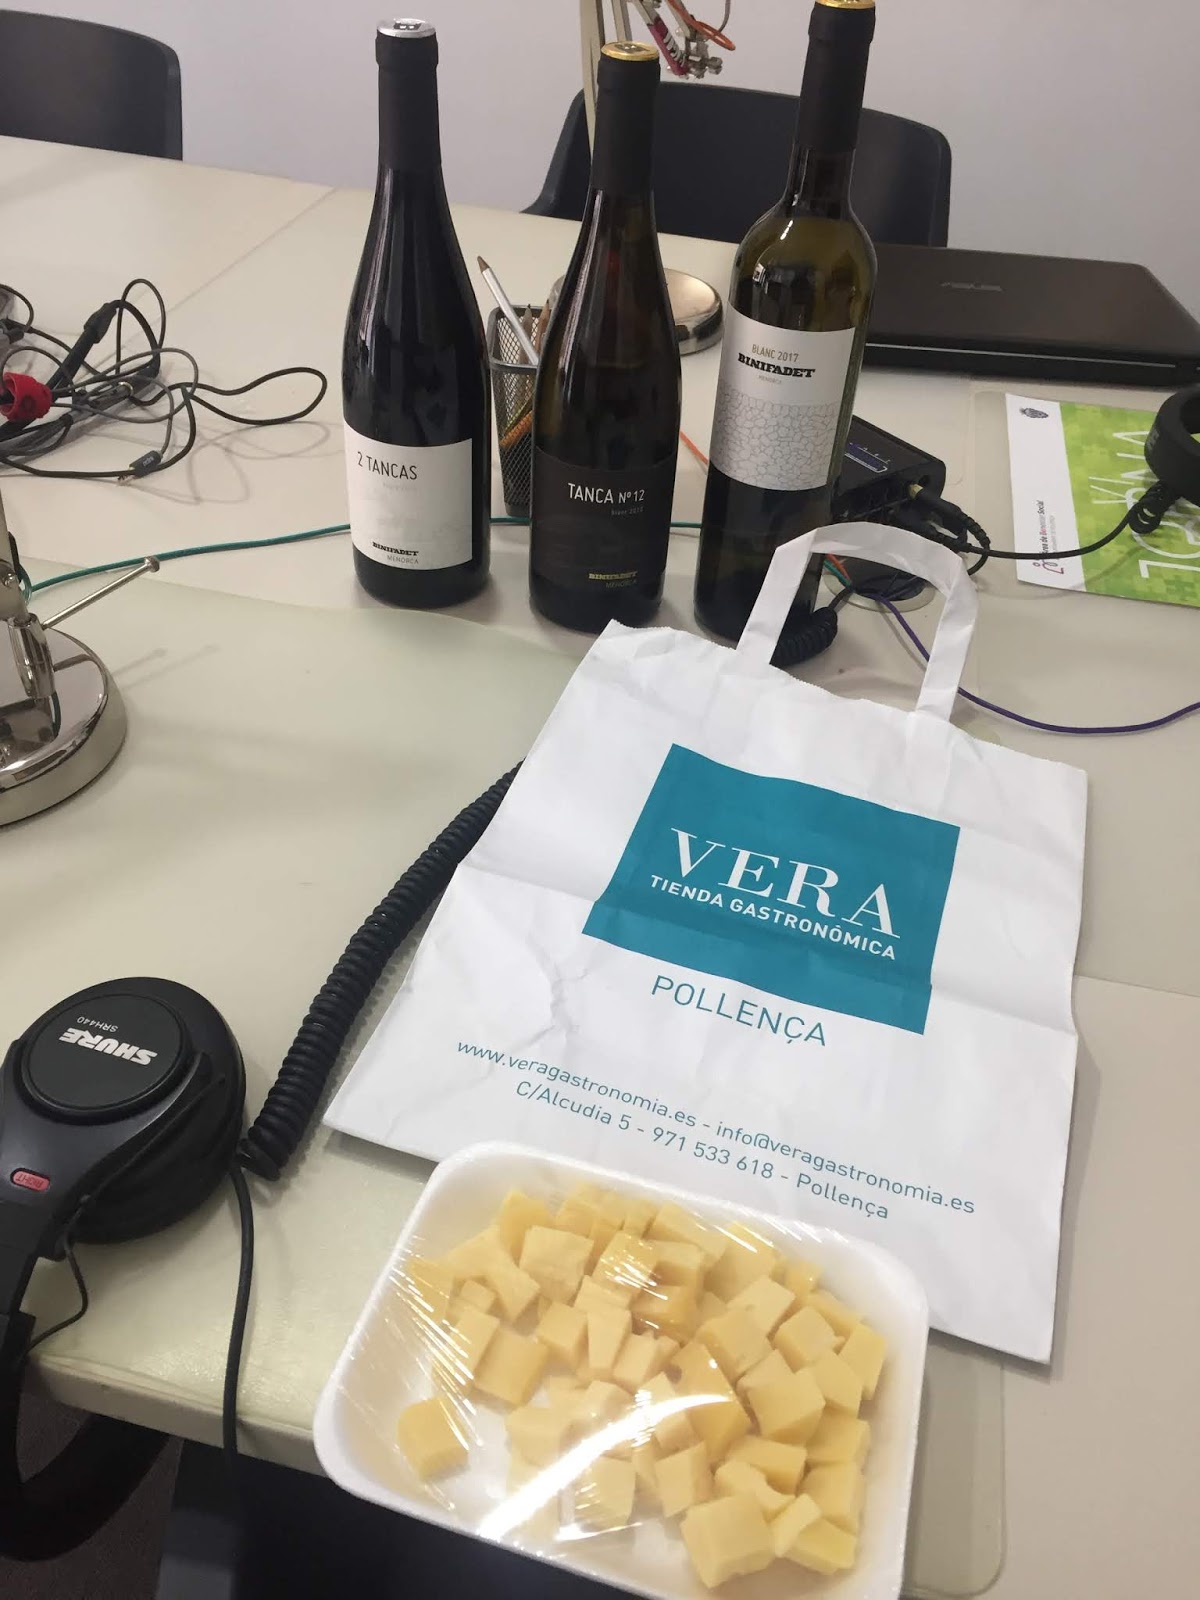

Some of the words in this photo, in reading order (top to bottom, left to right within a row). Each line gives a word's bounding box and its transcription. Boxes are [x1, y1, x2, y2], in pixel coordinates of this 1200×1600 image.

[737, 352, 816, 378] BINIFADET
[751, 343, 775, 359] BLANC
[777, 350, 799, 363] 2017
[357, 451, 363, 468] 2
[366, 455, 418, 480] TANCAS
[567, 482, 614, 504] TANCA
[634, 489, 645, 502] 12
[372, 541, 419, 556] BINIFADET
[386, 555, 419, 565] MENORCA
[650, 874, 724, 908] TIENDA
[670, 827, 901, 939] VERA
[77, 1016, 118, 1033] SRH440
[651, 974, 827, 1047] POLLENÇA
[58, 1027, 158, 1066] SHURE
[457, 1041, 697, 1128] www.veragastronomia.es
[716, 1120, 976, 1214] info@veragastronomia.es
[515, 1080, 612, 1125] C/Alcudia
[618, 1114, 632, 1131] 5
[652, 1126, 687, 1152] 971
[693, 1141, 731, 1165] 533
[736, 1155, 774, 1180] 618
[796, 1172, 890, 1219] Pollença
